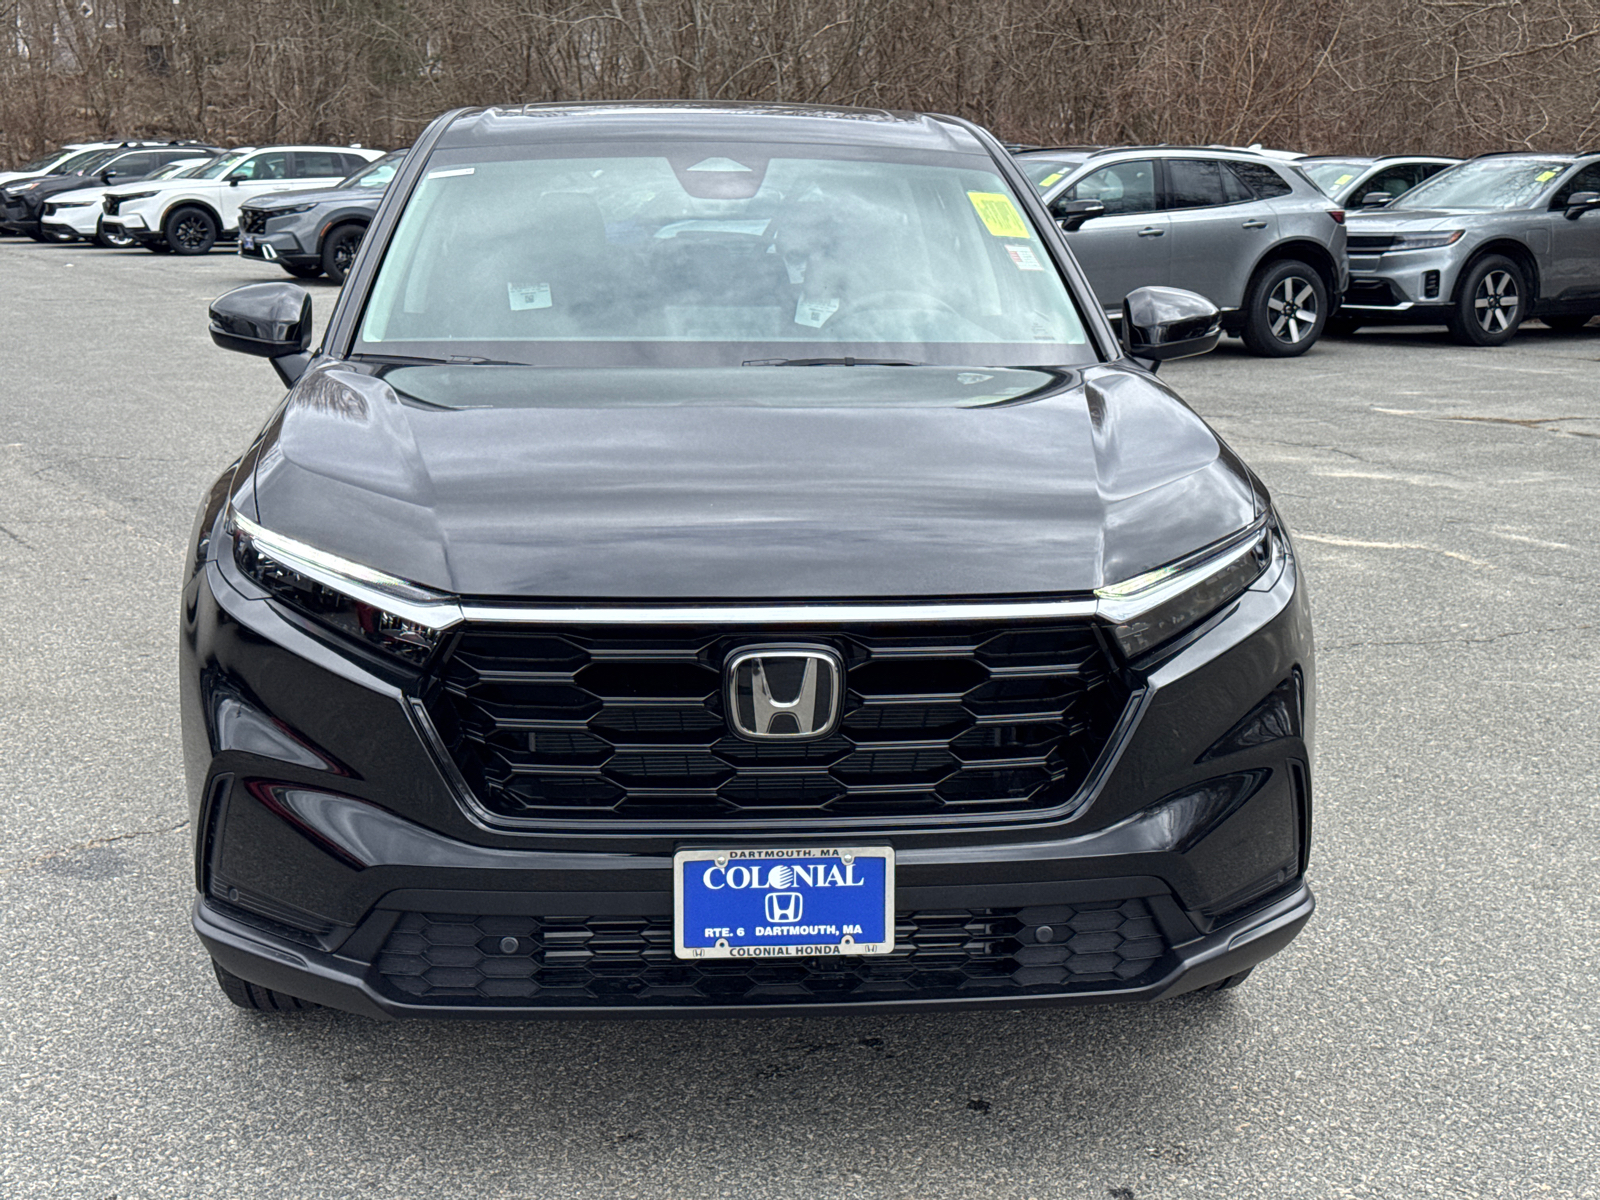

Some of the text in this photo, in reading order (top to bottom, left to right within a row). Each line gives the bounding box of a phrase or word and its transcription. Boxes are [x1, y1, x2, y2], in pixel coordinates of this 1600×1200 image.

[820, 849, 840, 857] MA
[702, 864, 865, 890] COLONIAL
[704, 924, 863, 938] RTE. 6 DARTMOUTH, MA
[729, 945, 841, 957] COLONIAL HONDA
